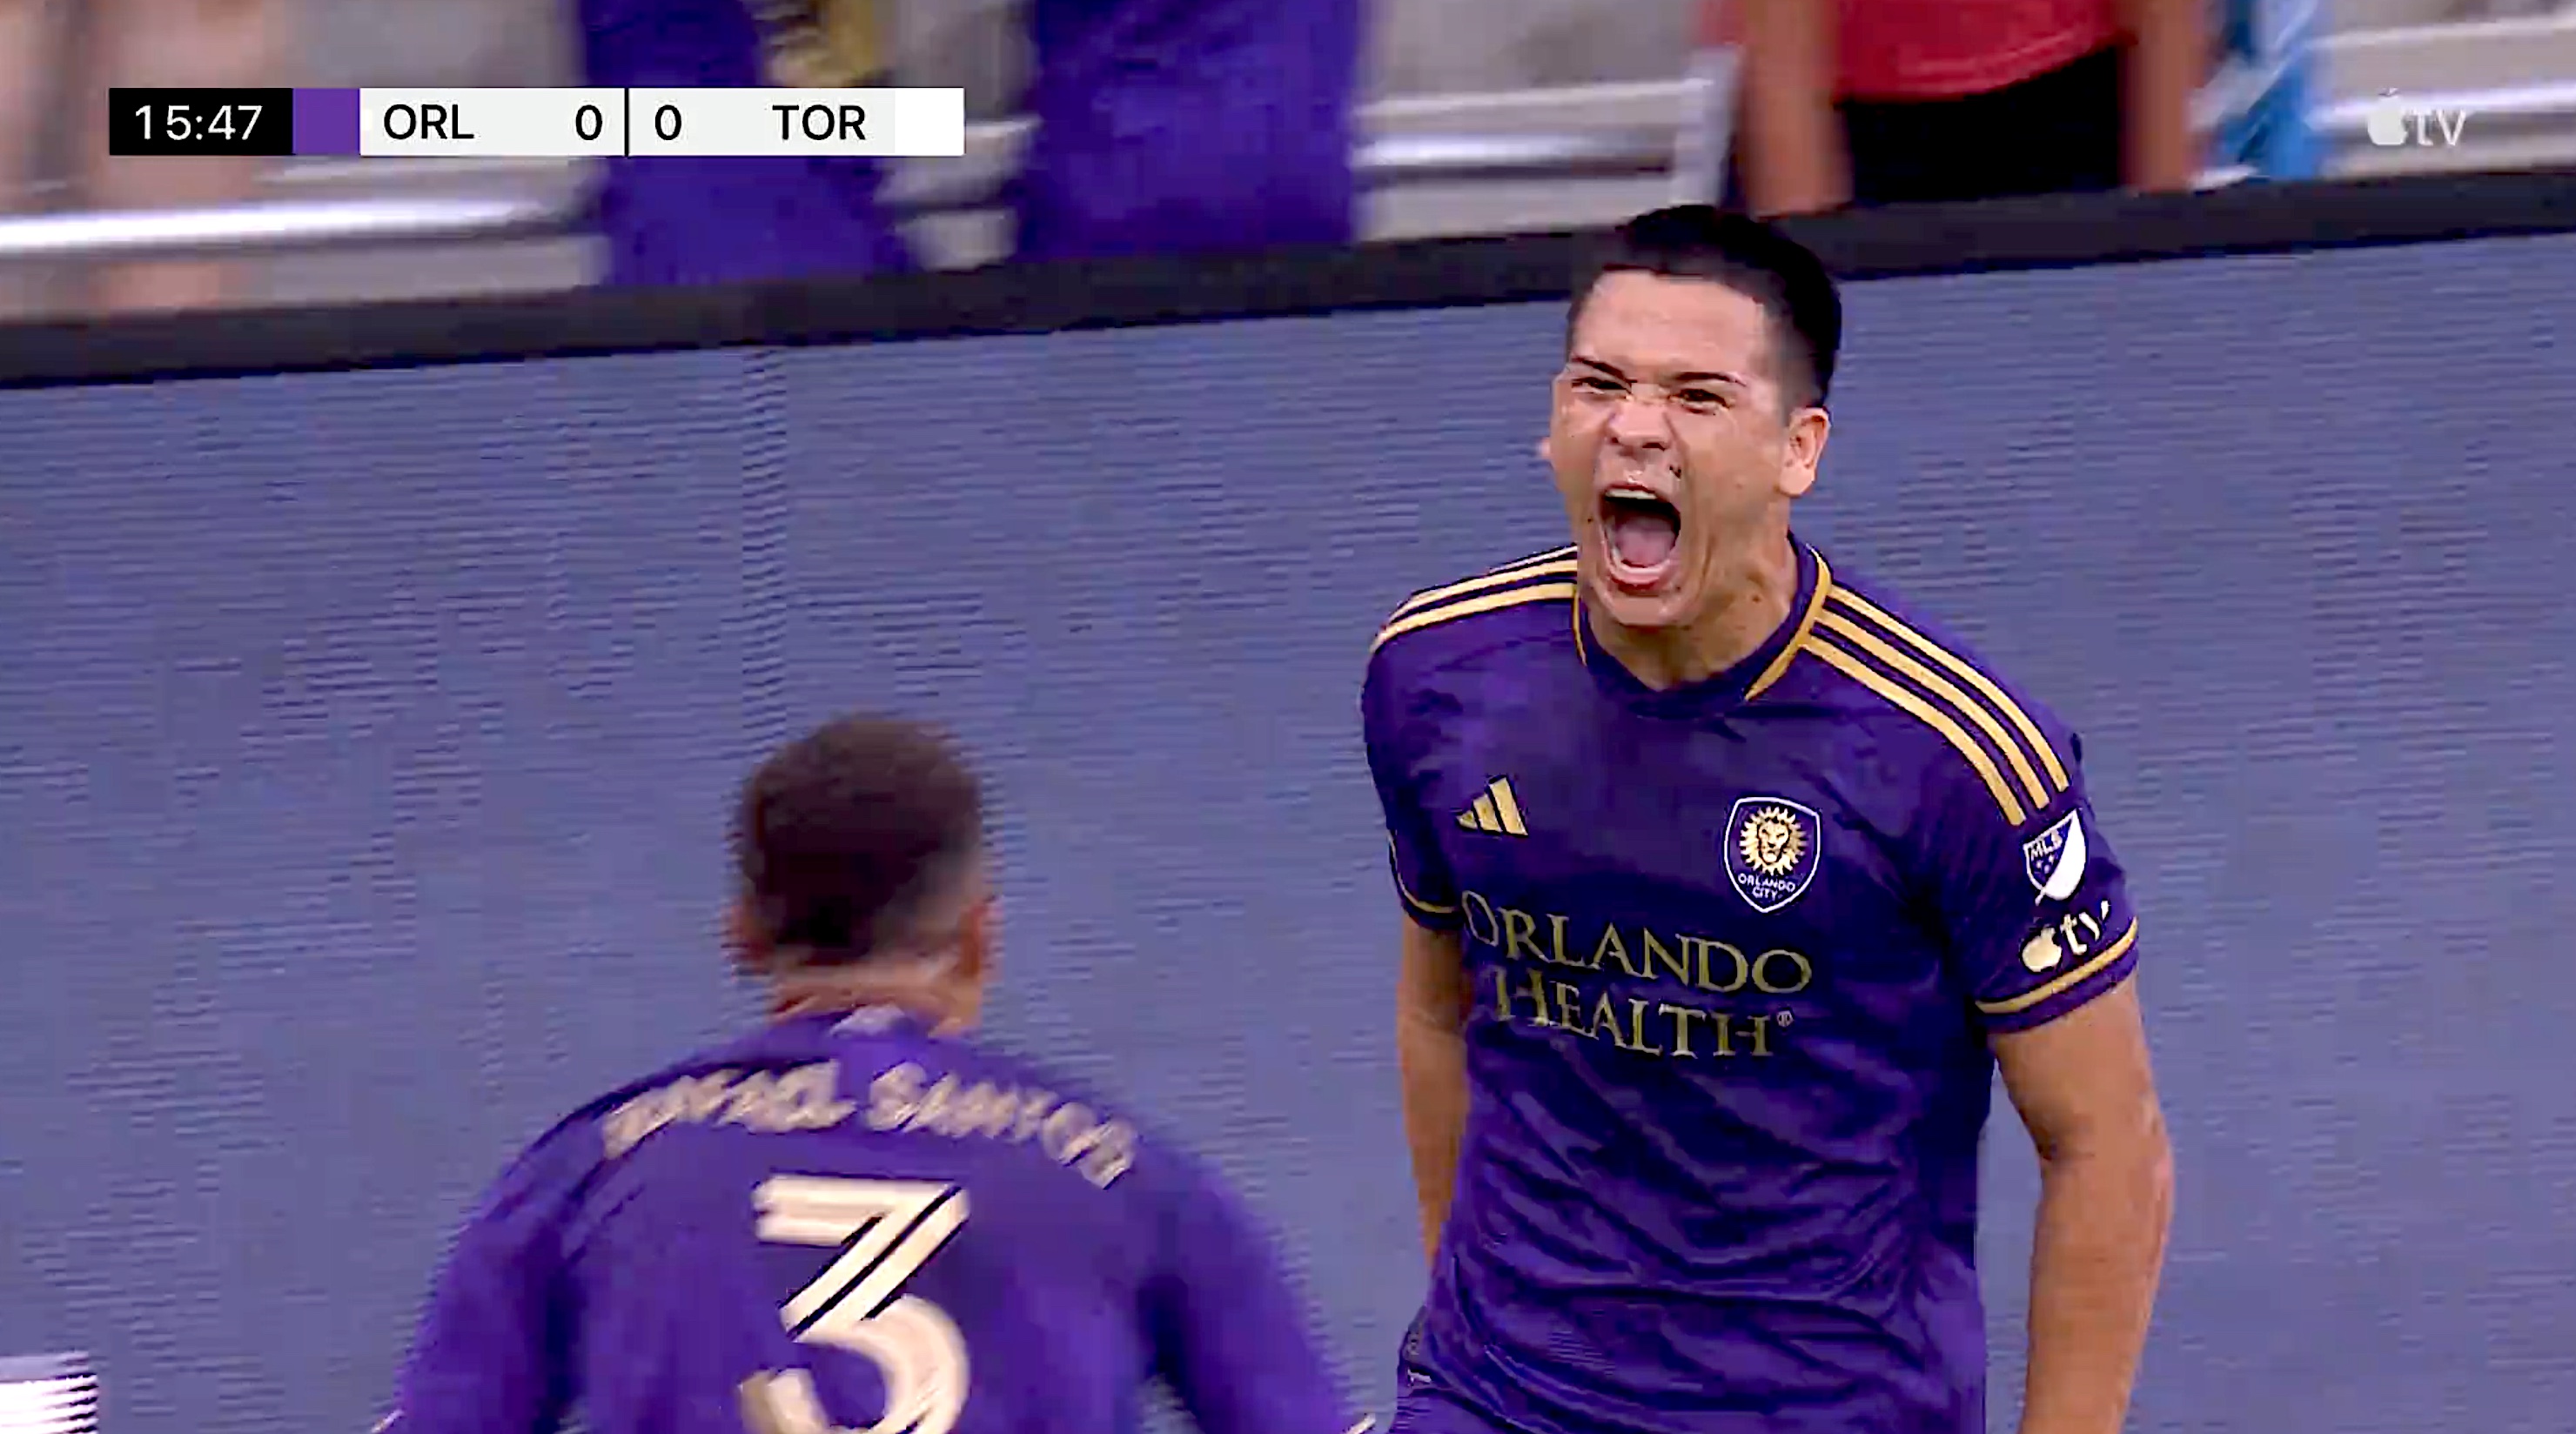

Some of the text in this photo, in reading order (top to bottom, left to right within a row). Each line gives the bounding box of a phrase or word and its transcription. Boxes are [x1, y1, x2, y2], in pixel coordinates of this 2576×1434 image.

[1738, 873, 1795, 892] ORLANDO
[1752, 887, 1779, 901] CITY
[1462, 890, 1812, 993] ORLANDO
[738, 1175, 971, 1434] 3
